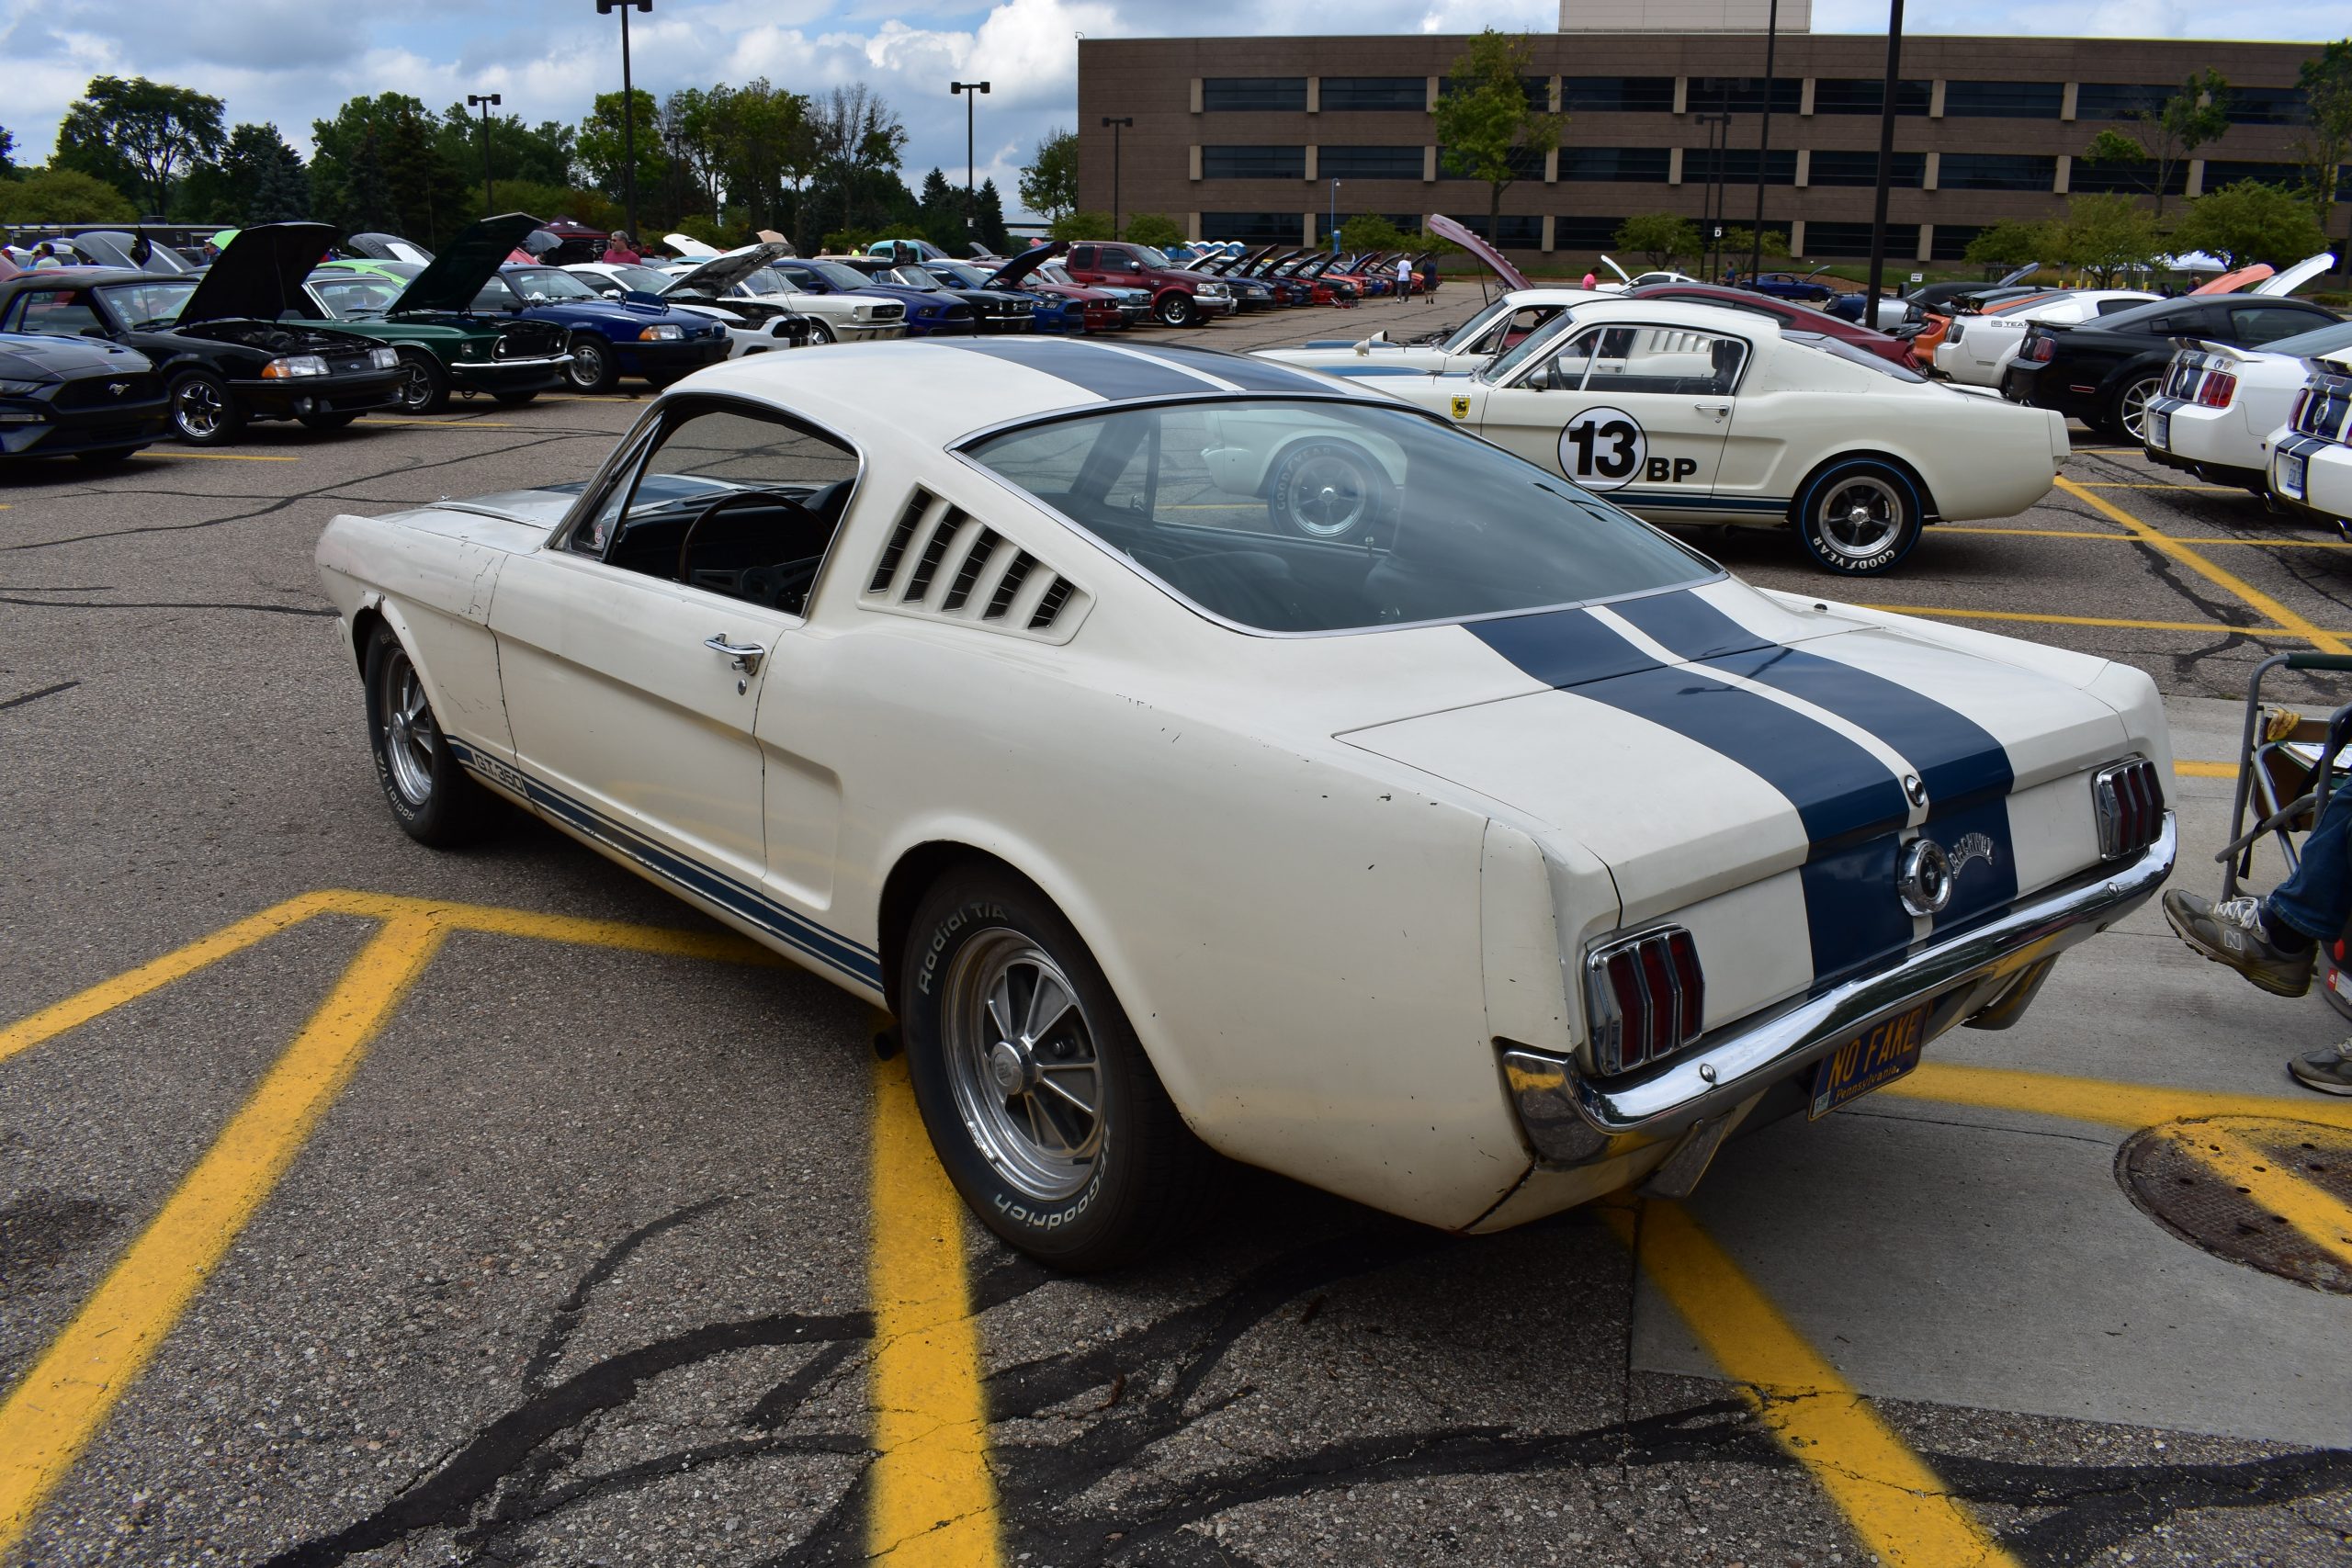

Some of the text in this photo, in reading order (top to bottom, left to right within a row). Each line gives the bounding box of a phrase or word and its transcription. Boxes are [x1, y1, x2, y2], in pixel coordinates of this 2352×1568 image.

[1568, 420, 1697, 483] 13 BP
[1813, 536, 1895, 570] GOODYEAR
[918, 907, 968, 995] Radial
[1826, 1007, 1923, 1091] NO FAKE
[993, 1124, 1111, 1231] BFGoodrich
